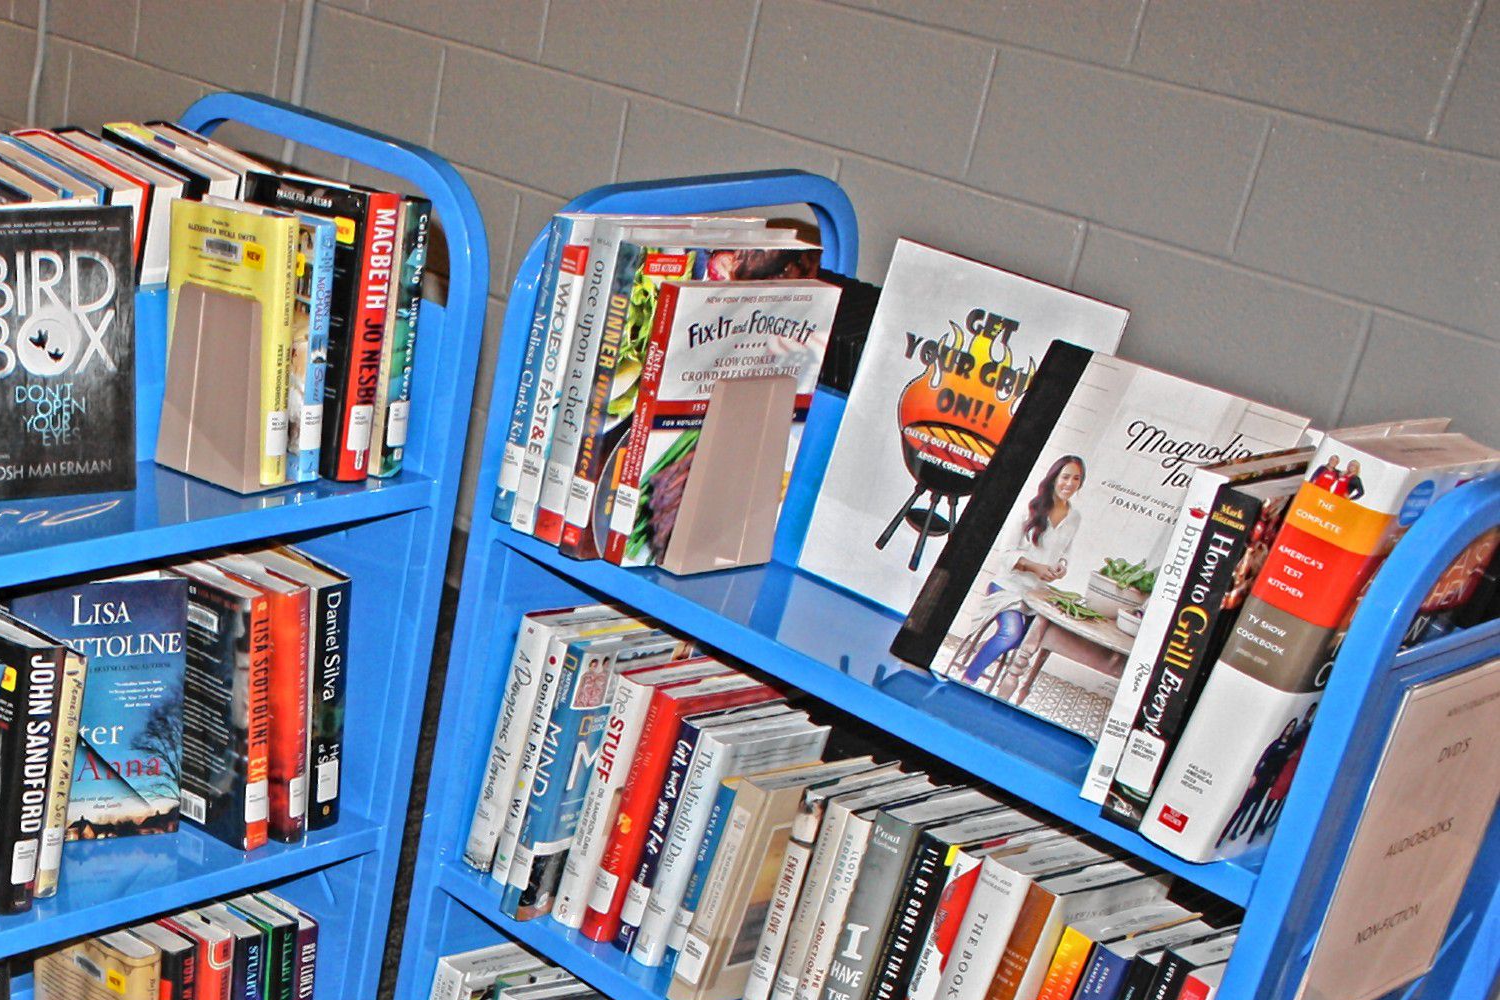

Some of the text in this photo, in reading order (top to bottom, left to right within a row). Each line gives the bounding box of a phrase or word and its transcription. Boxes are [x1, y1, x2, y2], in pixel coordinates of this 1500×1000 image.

[365, 208, 396, 310] MACBETH
[586, 259, 605, 307] once
[364, 318, 383, 343] JO
[525, 312, 547, 365] Melissa
[576, 314, 594, 363] upon
[598, 294, 628, 369] DINNER
[965, 306, 1021, 343] GET
[714, 355, 776, 368] SLOW COOKER
[903, 331, 976, 379] YOUR
[682, 371, 719, 381] CROWD
[28, 458, 112, 478] MALERMAN
[1109, 496, 1154, 519] JOANNA
[1295, 508, 1342, 535] COMPLETE
[1316, 500, 1336, 513] THE
[1277, 544, 1324, 571] AMERICA'S
[1283, 564, 1304, 580] TEST
[1164, 531, 1235, 670] How to Grill
[1267, 577, 1304, 599] KITCHEN
[1235, 626, 1286, 656] COOKBOOK
[1248, 613, 1288, 638] TV SHOW
[322, 591, 341, 701] Daniel Silva
[251, 616, 271, 749] LISA SCOTTOLINE
[535, 673, 554, 723] Daniel
[614, 685, 633, 714] the
[21, 655, 55, 834] JOHN SANDFORD
[521, 742, 537, 774] Pink
[532, 723, 562, 797] MIND
[595, 716, 625, 784] STUFF
[76, 752, 161, 781] Anna
[699, 751, 714, 777] The
[672, 782, 699, 842] Mindful
[842, 923, 869, 961] I
[965, 912, 989, 952] THE
[831, 960, 863, 988] HAVE
[948, 950, 973, 996] BOOK
